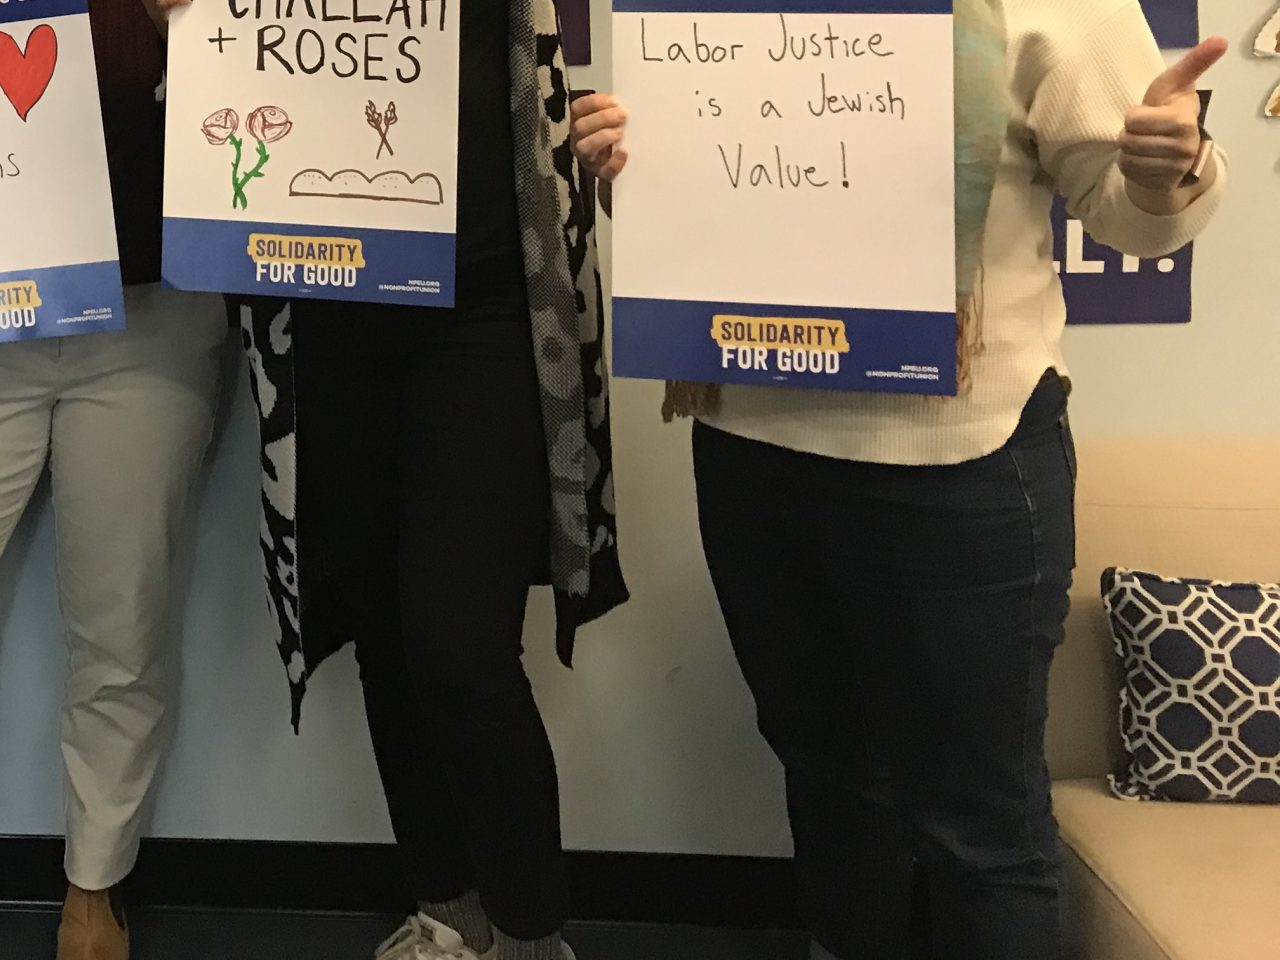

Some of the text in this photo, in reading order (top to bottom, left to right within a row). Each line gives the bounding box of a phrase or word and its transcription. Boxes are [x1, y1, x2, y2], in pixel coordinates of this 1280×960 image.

[255, 24, 421, 83] ROSES
[640, 14, 895, 64] Labor Justice
[696, 73, 905, 120] is a Jewish
[718, 142, 850, 189] Value!
[256, 239, 358, 262] SOLIDARITY
[256, 261, 357, 287] FOR GOOD
[721, 321, 840, 346] SOLIDARITY
[722, 345, 840, 374] FOR GOOD
